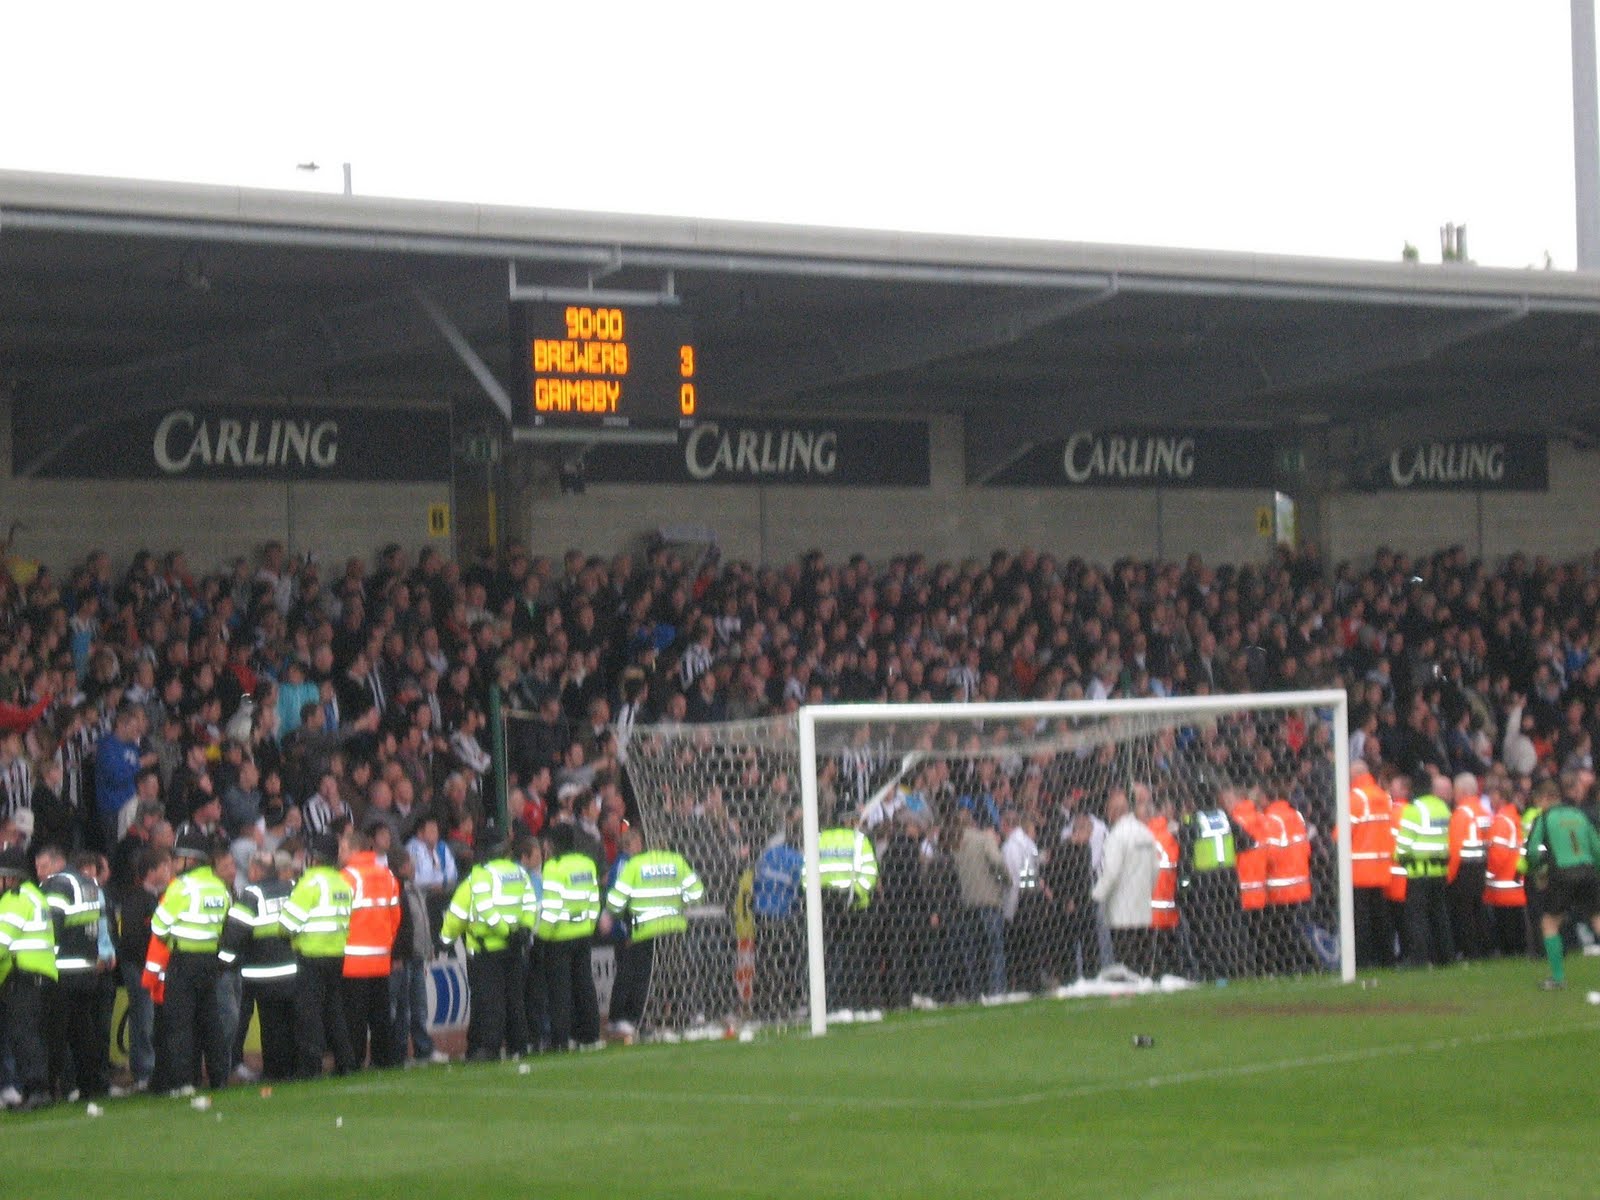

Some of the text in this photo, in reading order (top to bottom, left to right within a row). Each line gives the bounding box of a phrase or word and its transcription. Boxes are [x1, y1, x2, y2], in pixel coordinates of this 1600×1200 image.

[565, 306, 623, 340] 90:00
[534, 339, 694, 378] BREWERS 3
[534, 378, 695, 415] GRIMSBY 0
[153, 410, 338, 473] CARLING
[685, 421, 837, 480] CARLING
[1064, 430, 1196, 483] CARLING
[1390, 441, 1505, 486] CARLING
[641, 864, 676, 877] POLICE
